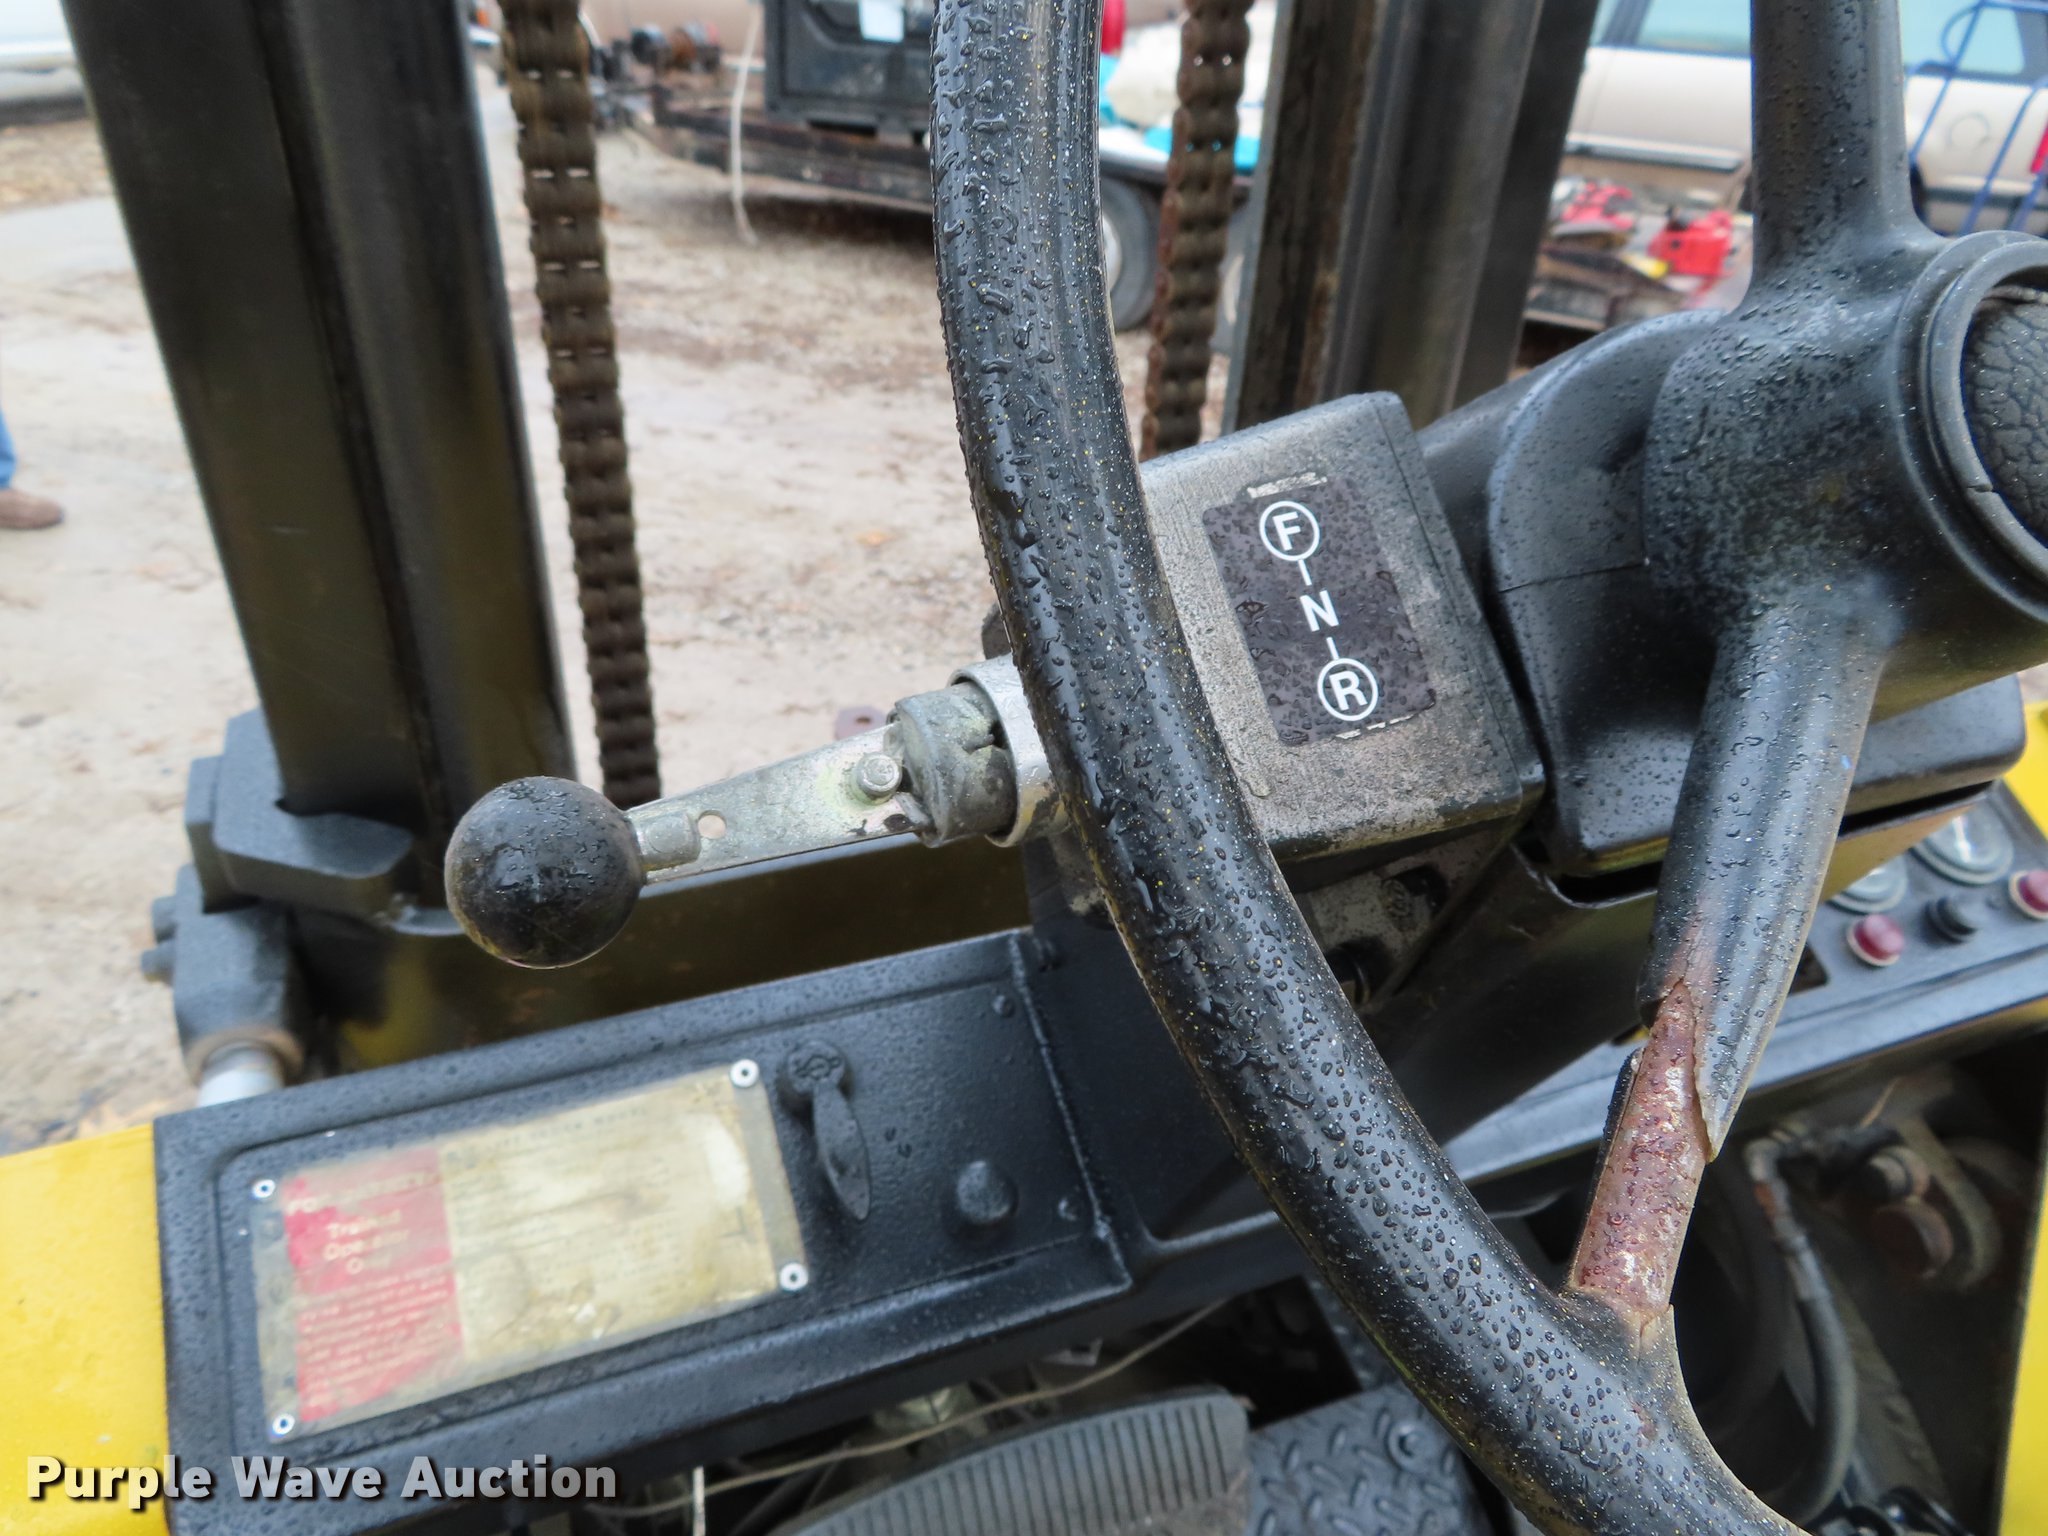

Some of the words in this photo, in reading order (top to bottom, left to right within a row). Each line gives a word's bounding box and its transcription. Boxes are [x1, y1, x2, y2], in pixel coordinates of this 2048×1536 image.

[1273, 511, 1302, 552] F
[1300, 590, 1339, 632] N
[1329, 670, 1368, 711] R
